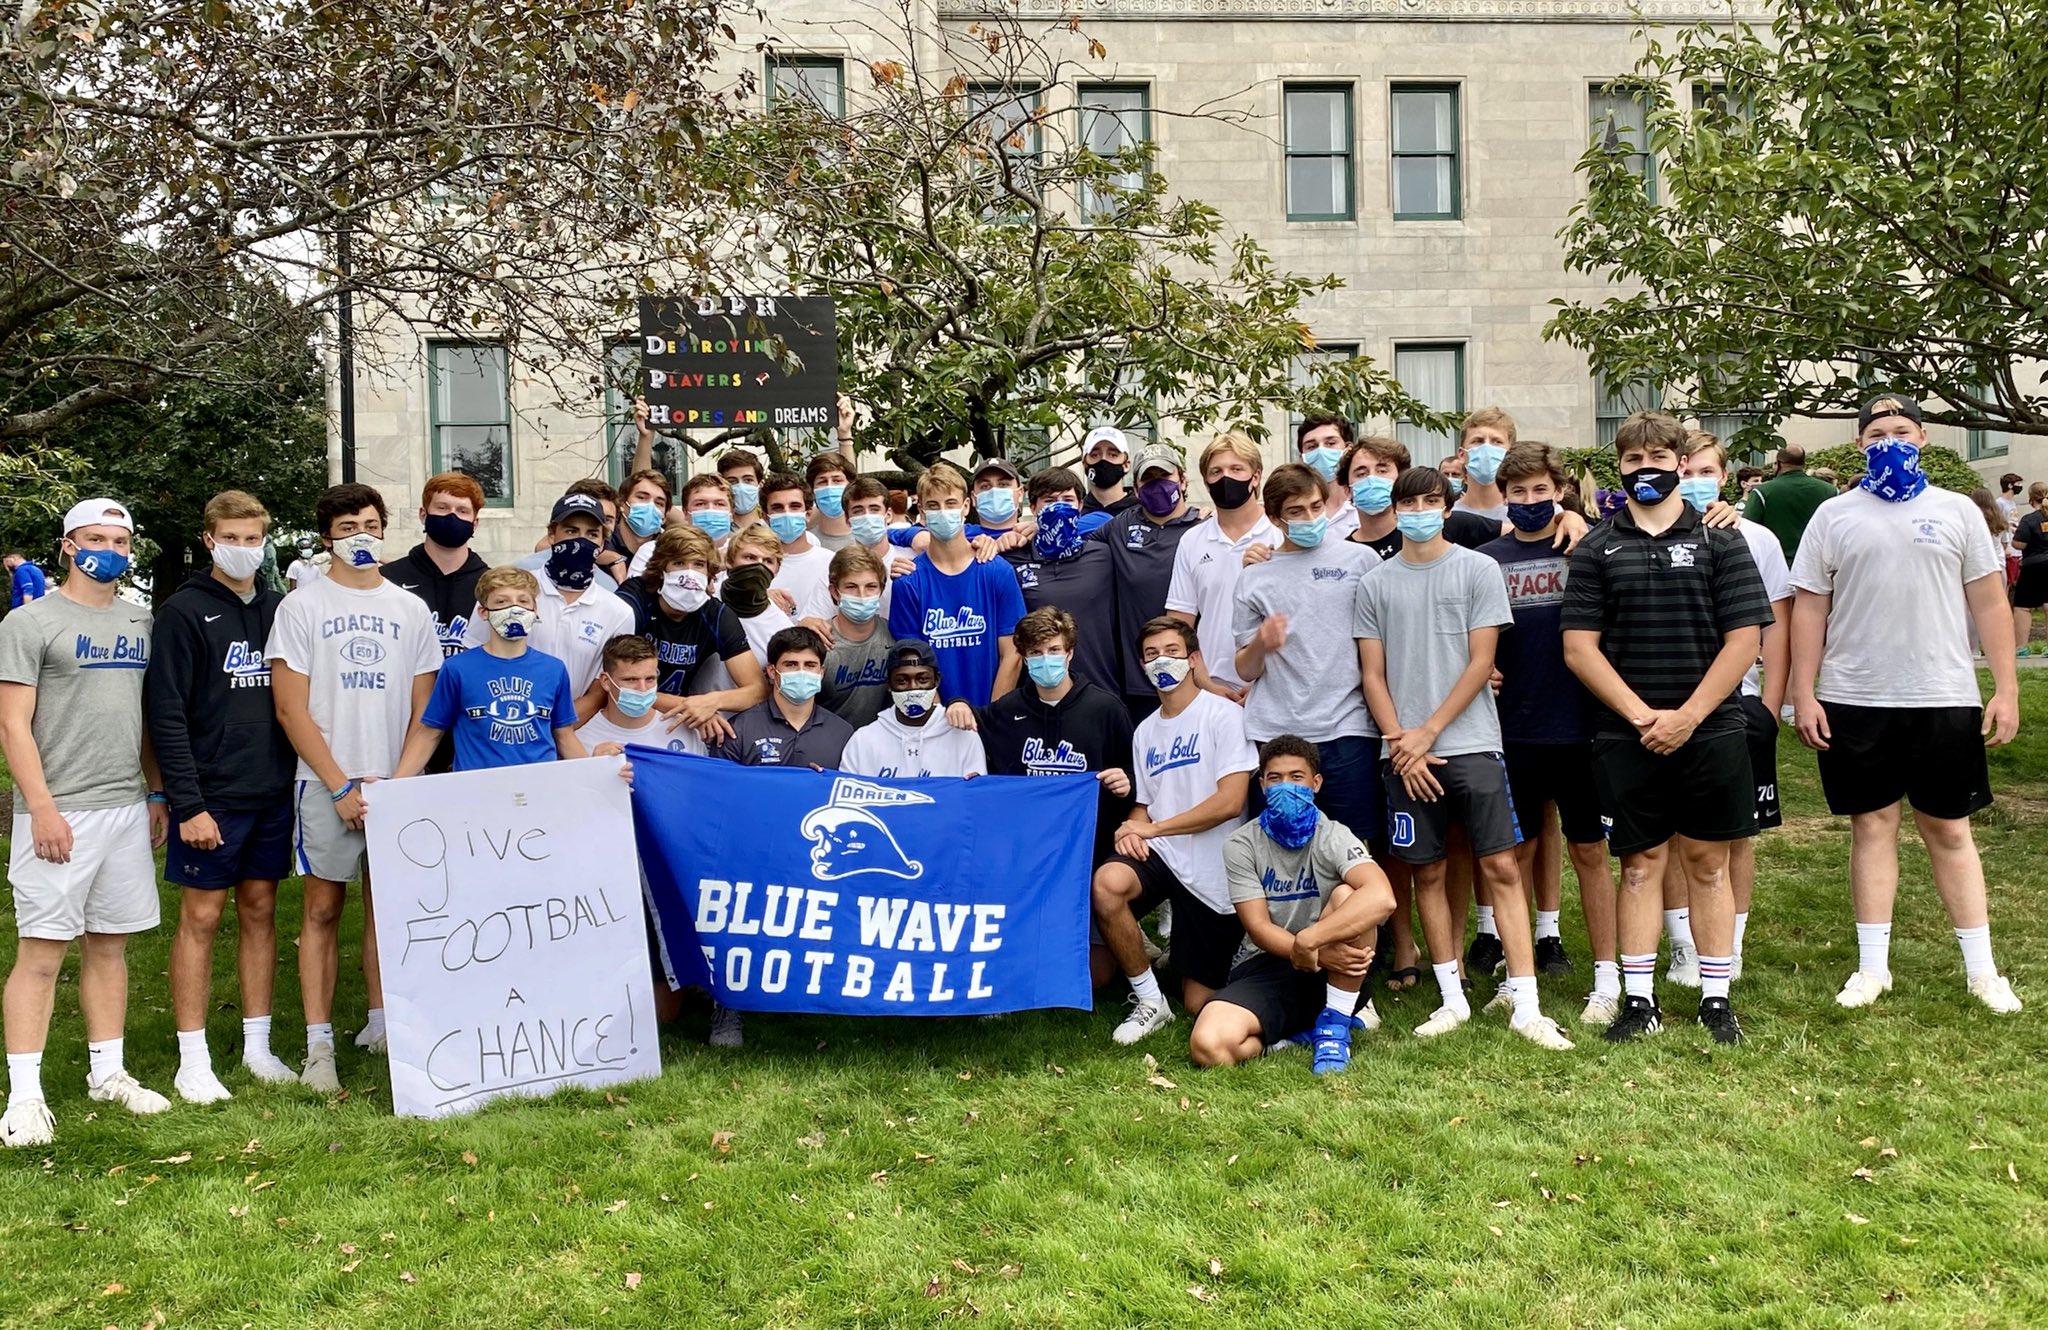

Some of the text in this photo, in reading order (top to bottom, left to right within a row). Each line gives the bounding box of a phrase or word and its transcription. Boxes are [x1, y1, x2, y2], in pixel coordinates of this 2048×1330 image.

[645, 335, 770, 356] DESTROYIN
[649, 404, 828, 425] HOPES AND DREAMS
[322, 614, 401, 640] COACH T
[923, 606, 986, 636] Blue Wave
[75, 634, 149, 663] Wave Ball
[928, 636, 982, 649] FOOTBALL
[223, 640, 263, 673] Blue
[230, 675, 270, 689] FOOTB
[339, 670, 386, 690] WINS
[486, 676, 534, 698] BLUE
[489, 721, 539, 745] WAVE
[1169, 732, 1200, 760] Ball
[1022, 737, 1087, 767] Blue Wave
[840, 785, 907, 801] DARIEN
[1757, 783, 1775, 802] 70
[1392, 811, 1416, 847] D
[1261, 866, 1293, 892] Wave
[694, 878, 1007, 953] BLUE WAVE
[400, 887, 627, 972] FOOTBALL
[505, 987, 526, 1008] A
[426, 983, 638, 1091] CHANCE!
